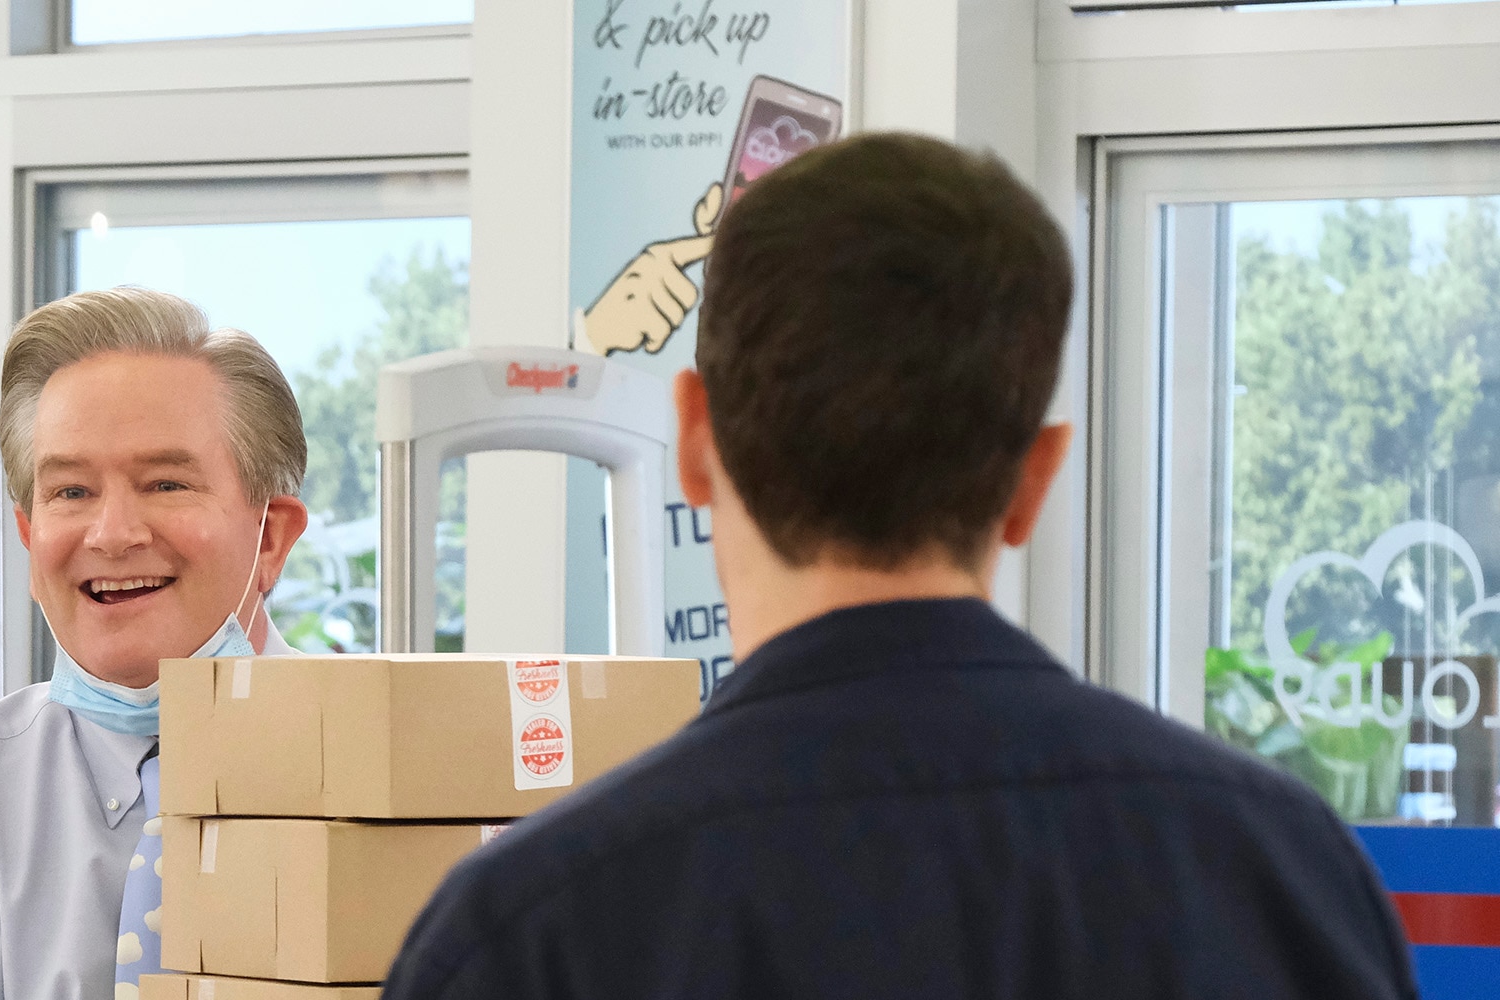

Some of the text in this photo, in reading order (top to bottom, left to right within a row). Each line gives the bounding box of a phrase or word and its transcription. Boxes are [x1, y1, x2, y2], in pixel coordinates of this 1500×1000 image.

[634, 0, 719, 69] pick
[725, 11, 770, 65] up
[593, 70, 726, 120] in-store
[607, 132, 722, 149] WITH OUR APP!
